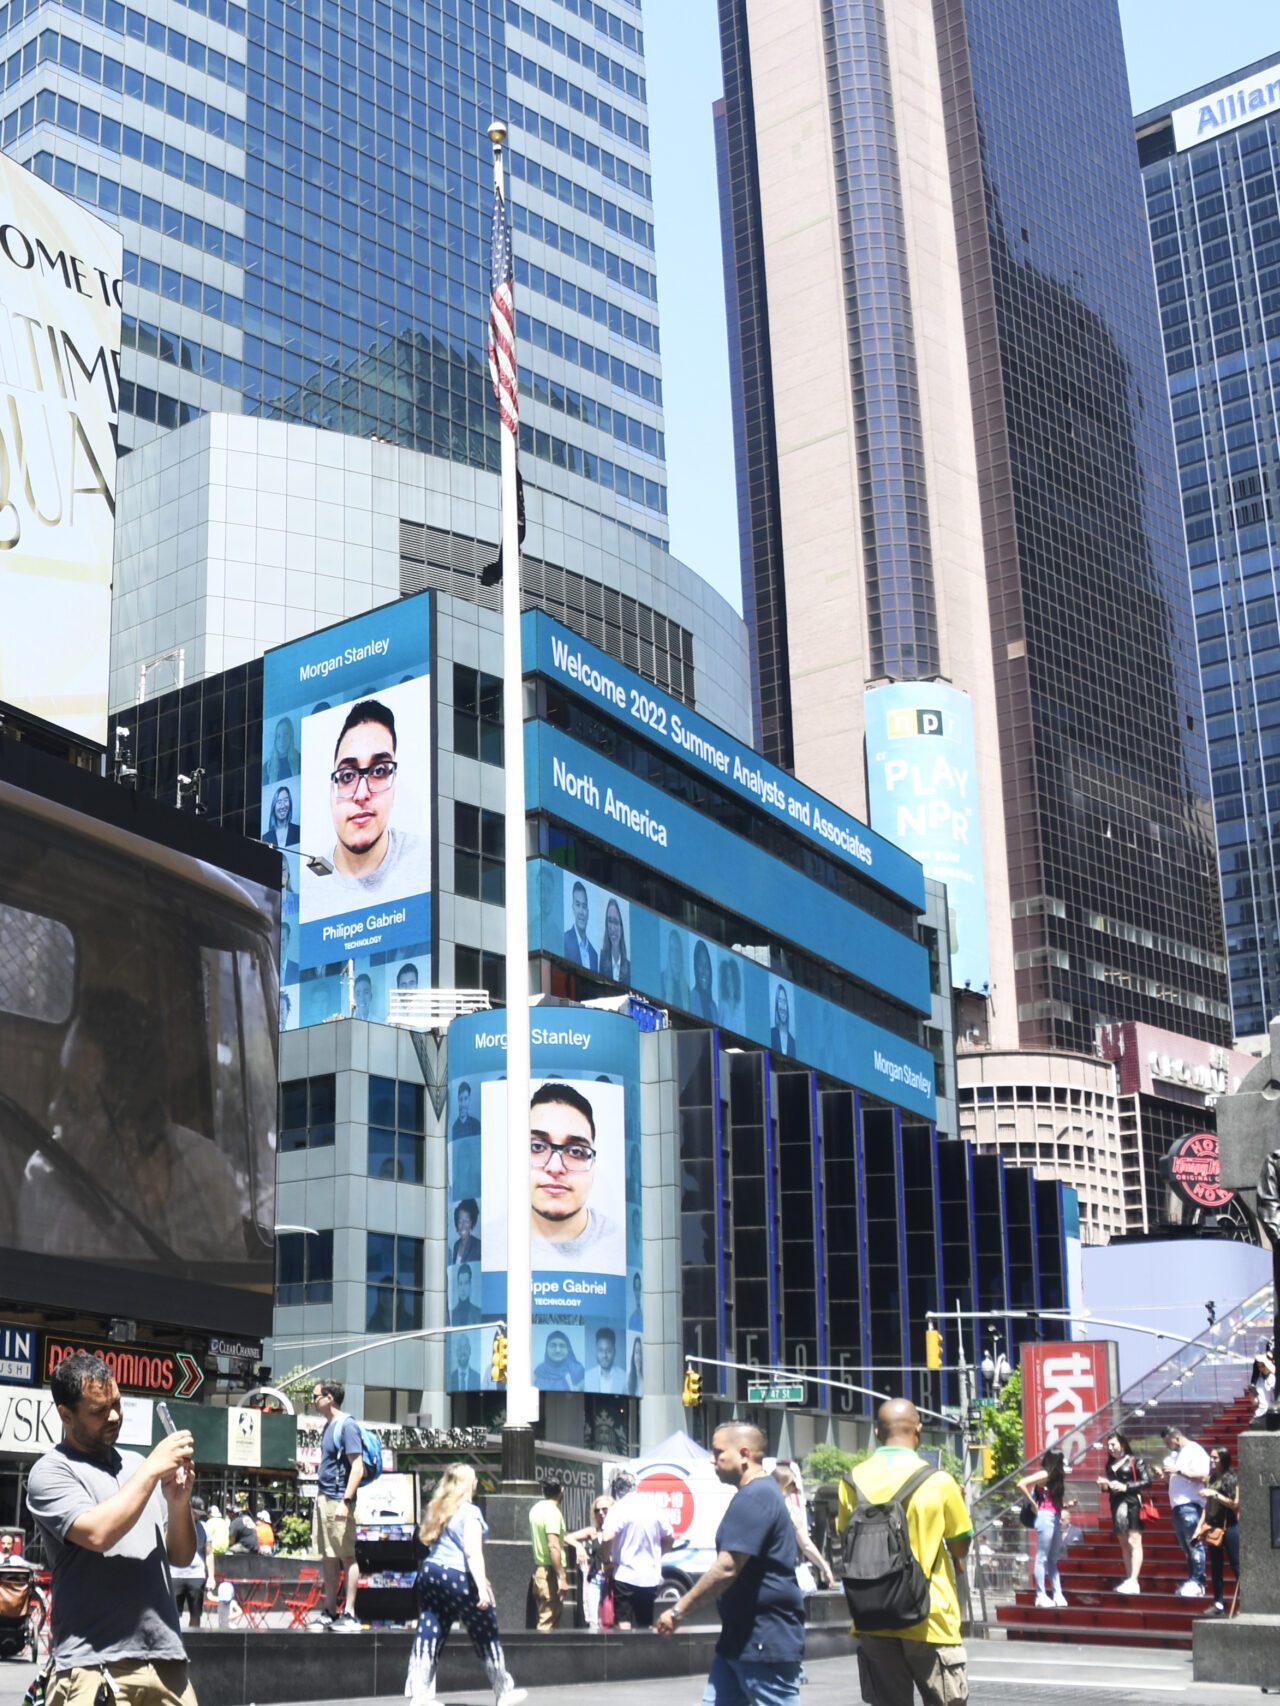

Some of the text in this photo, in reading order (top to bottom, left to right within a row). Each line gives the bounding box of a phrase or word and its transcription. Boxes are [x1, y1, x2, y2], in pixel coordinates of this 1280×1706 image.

[12, 311, 120, 414] TIM
[299, 636, 391, 683] Morgan Stanley
[550, 633, 873, 867] Welcome 2022 Summer Analysts and Associates
[552, 755, 669, 849] North America
[322, 907, 407, 943] Philippe Gabriel
[343, 933, 383, 952] TECHNOLOGY
[475, 1028, 592, 1051] Morg Stanley
[873, 1050, 932, 1099] Morgan Stanley
[533, 1297, 582, 1307] TECHNOLOGY
[562, 1278, 607, 1295] Gabriel
[770, 1389, 780, 1400] 47
[782, 1389, 790, 1400] St
[1043, 1352, 1095, 1466] tkts
[535, 1466, 596, 1488] DISCOVER
